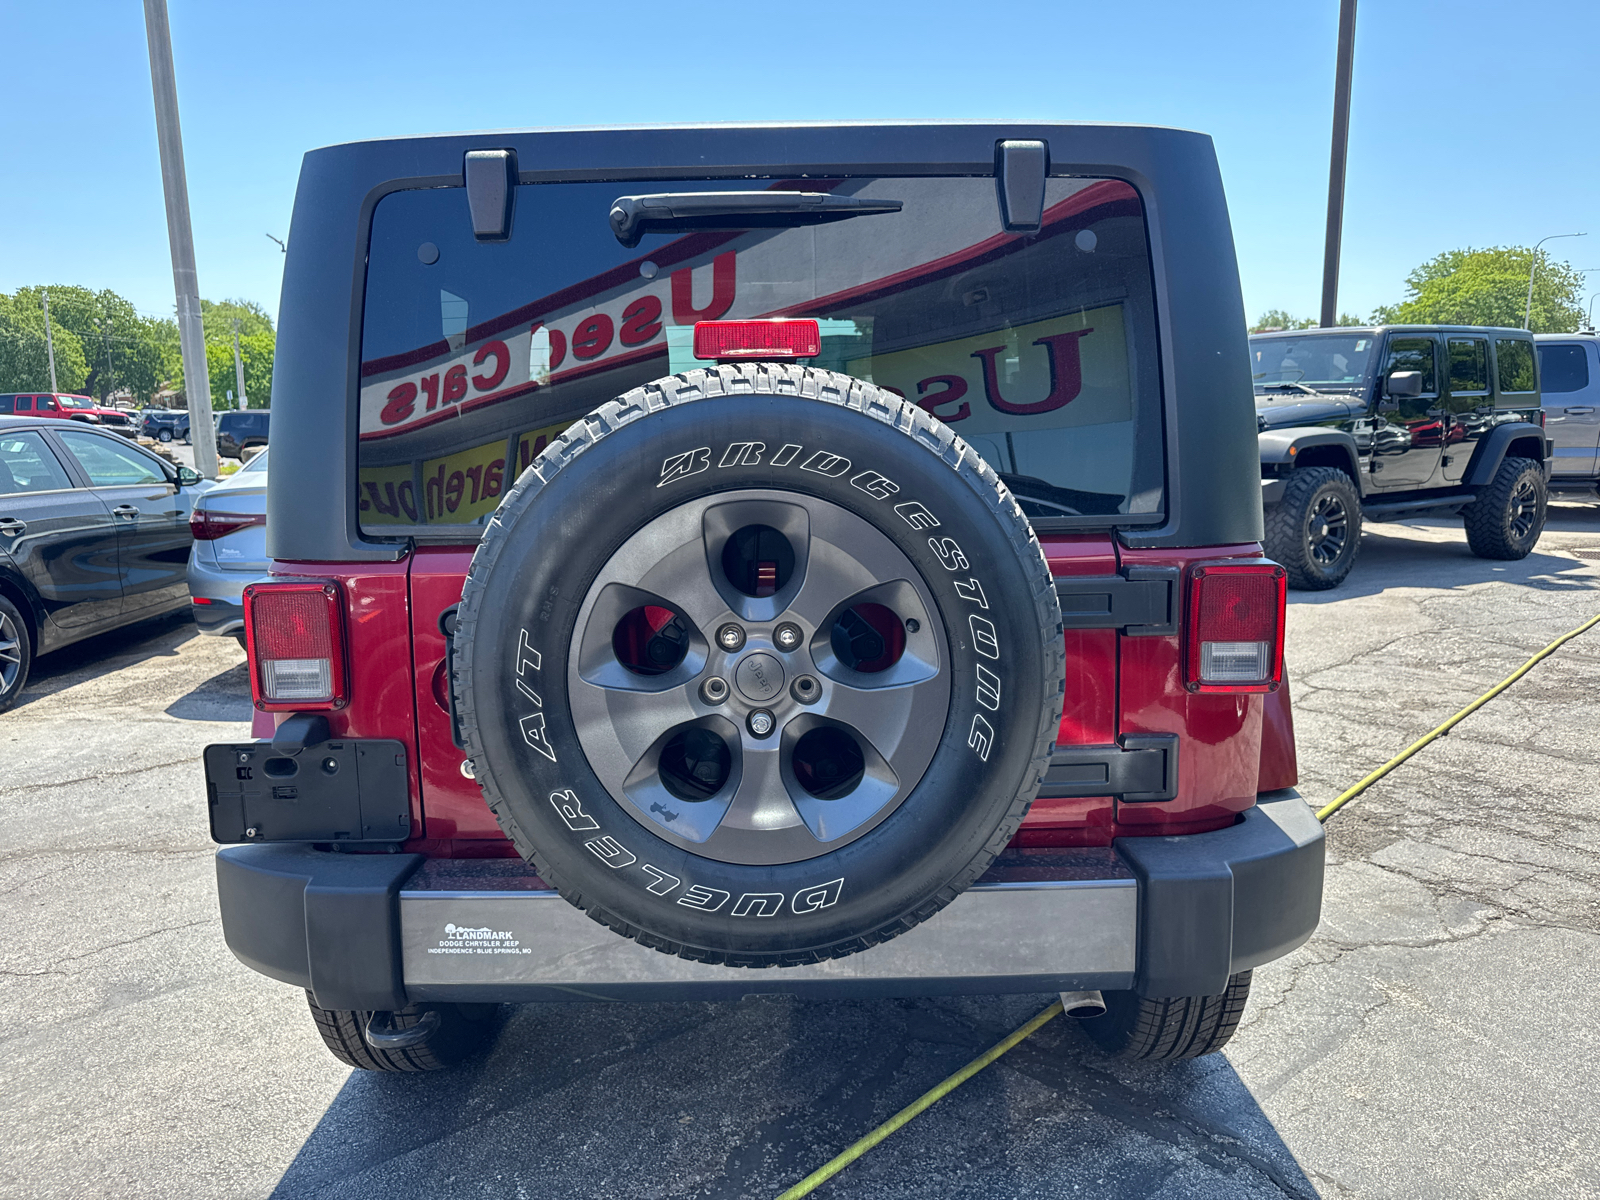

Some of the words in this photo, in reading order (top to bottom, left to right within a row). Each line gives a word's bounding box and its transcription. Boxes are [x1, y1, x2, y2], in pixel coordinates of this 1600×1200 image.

[656, 441, 1001, 762] BRIDGESTONE
[515, 628, 557, 762] A/T
[747, 660, 773, 694] Jeep
[549, 789, 845, 917] DUELER
[456, 931, 513, 940] LANDMARK
